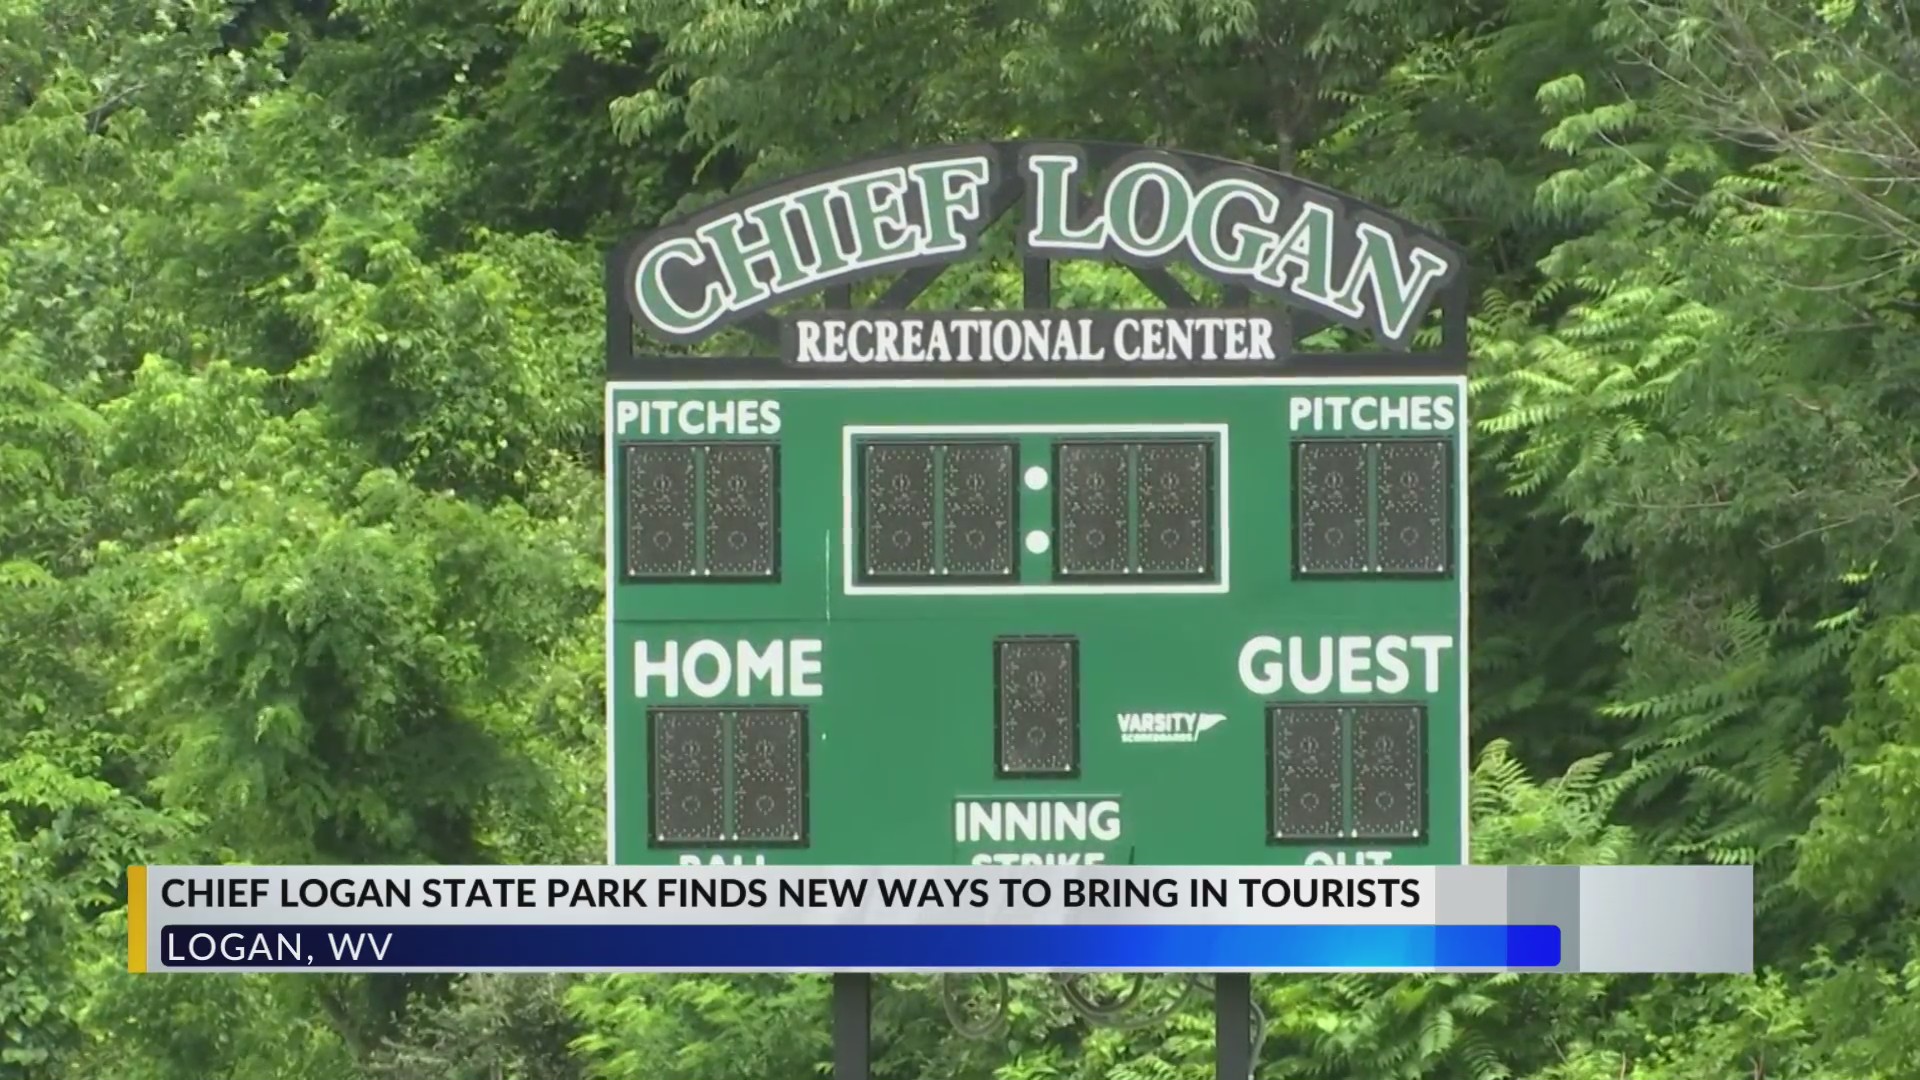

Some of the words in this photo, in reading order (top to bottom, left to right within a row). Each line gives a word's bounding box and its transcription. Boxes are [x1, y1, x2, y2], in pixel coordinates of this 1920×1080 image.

[633, 155, 990, 335] CHIEF
[1027, 154, 1446, 341] LOGAN
[796, 318, 1105, 363] RECREATIONAL
[1113, 317, 1276, 361] CENTER
[616, 399, 781, 436] PITCHES
[1289, 395, 1455, 432] PITCHES
[633, 639, 823, 698] HOME
[1238, 635, 1453, 695] GUEST
[1117, 712, 1197, 733] VARSITY
[955, 801, 1121, 842] INNING
